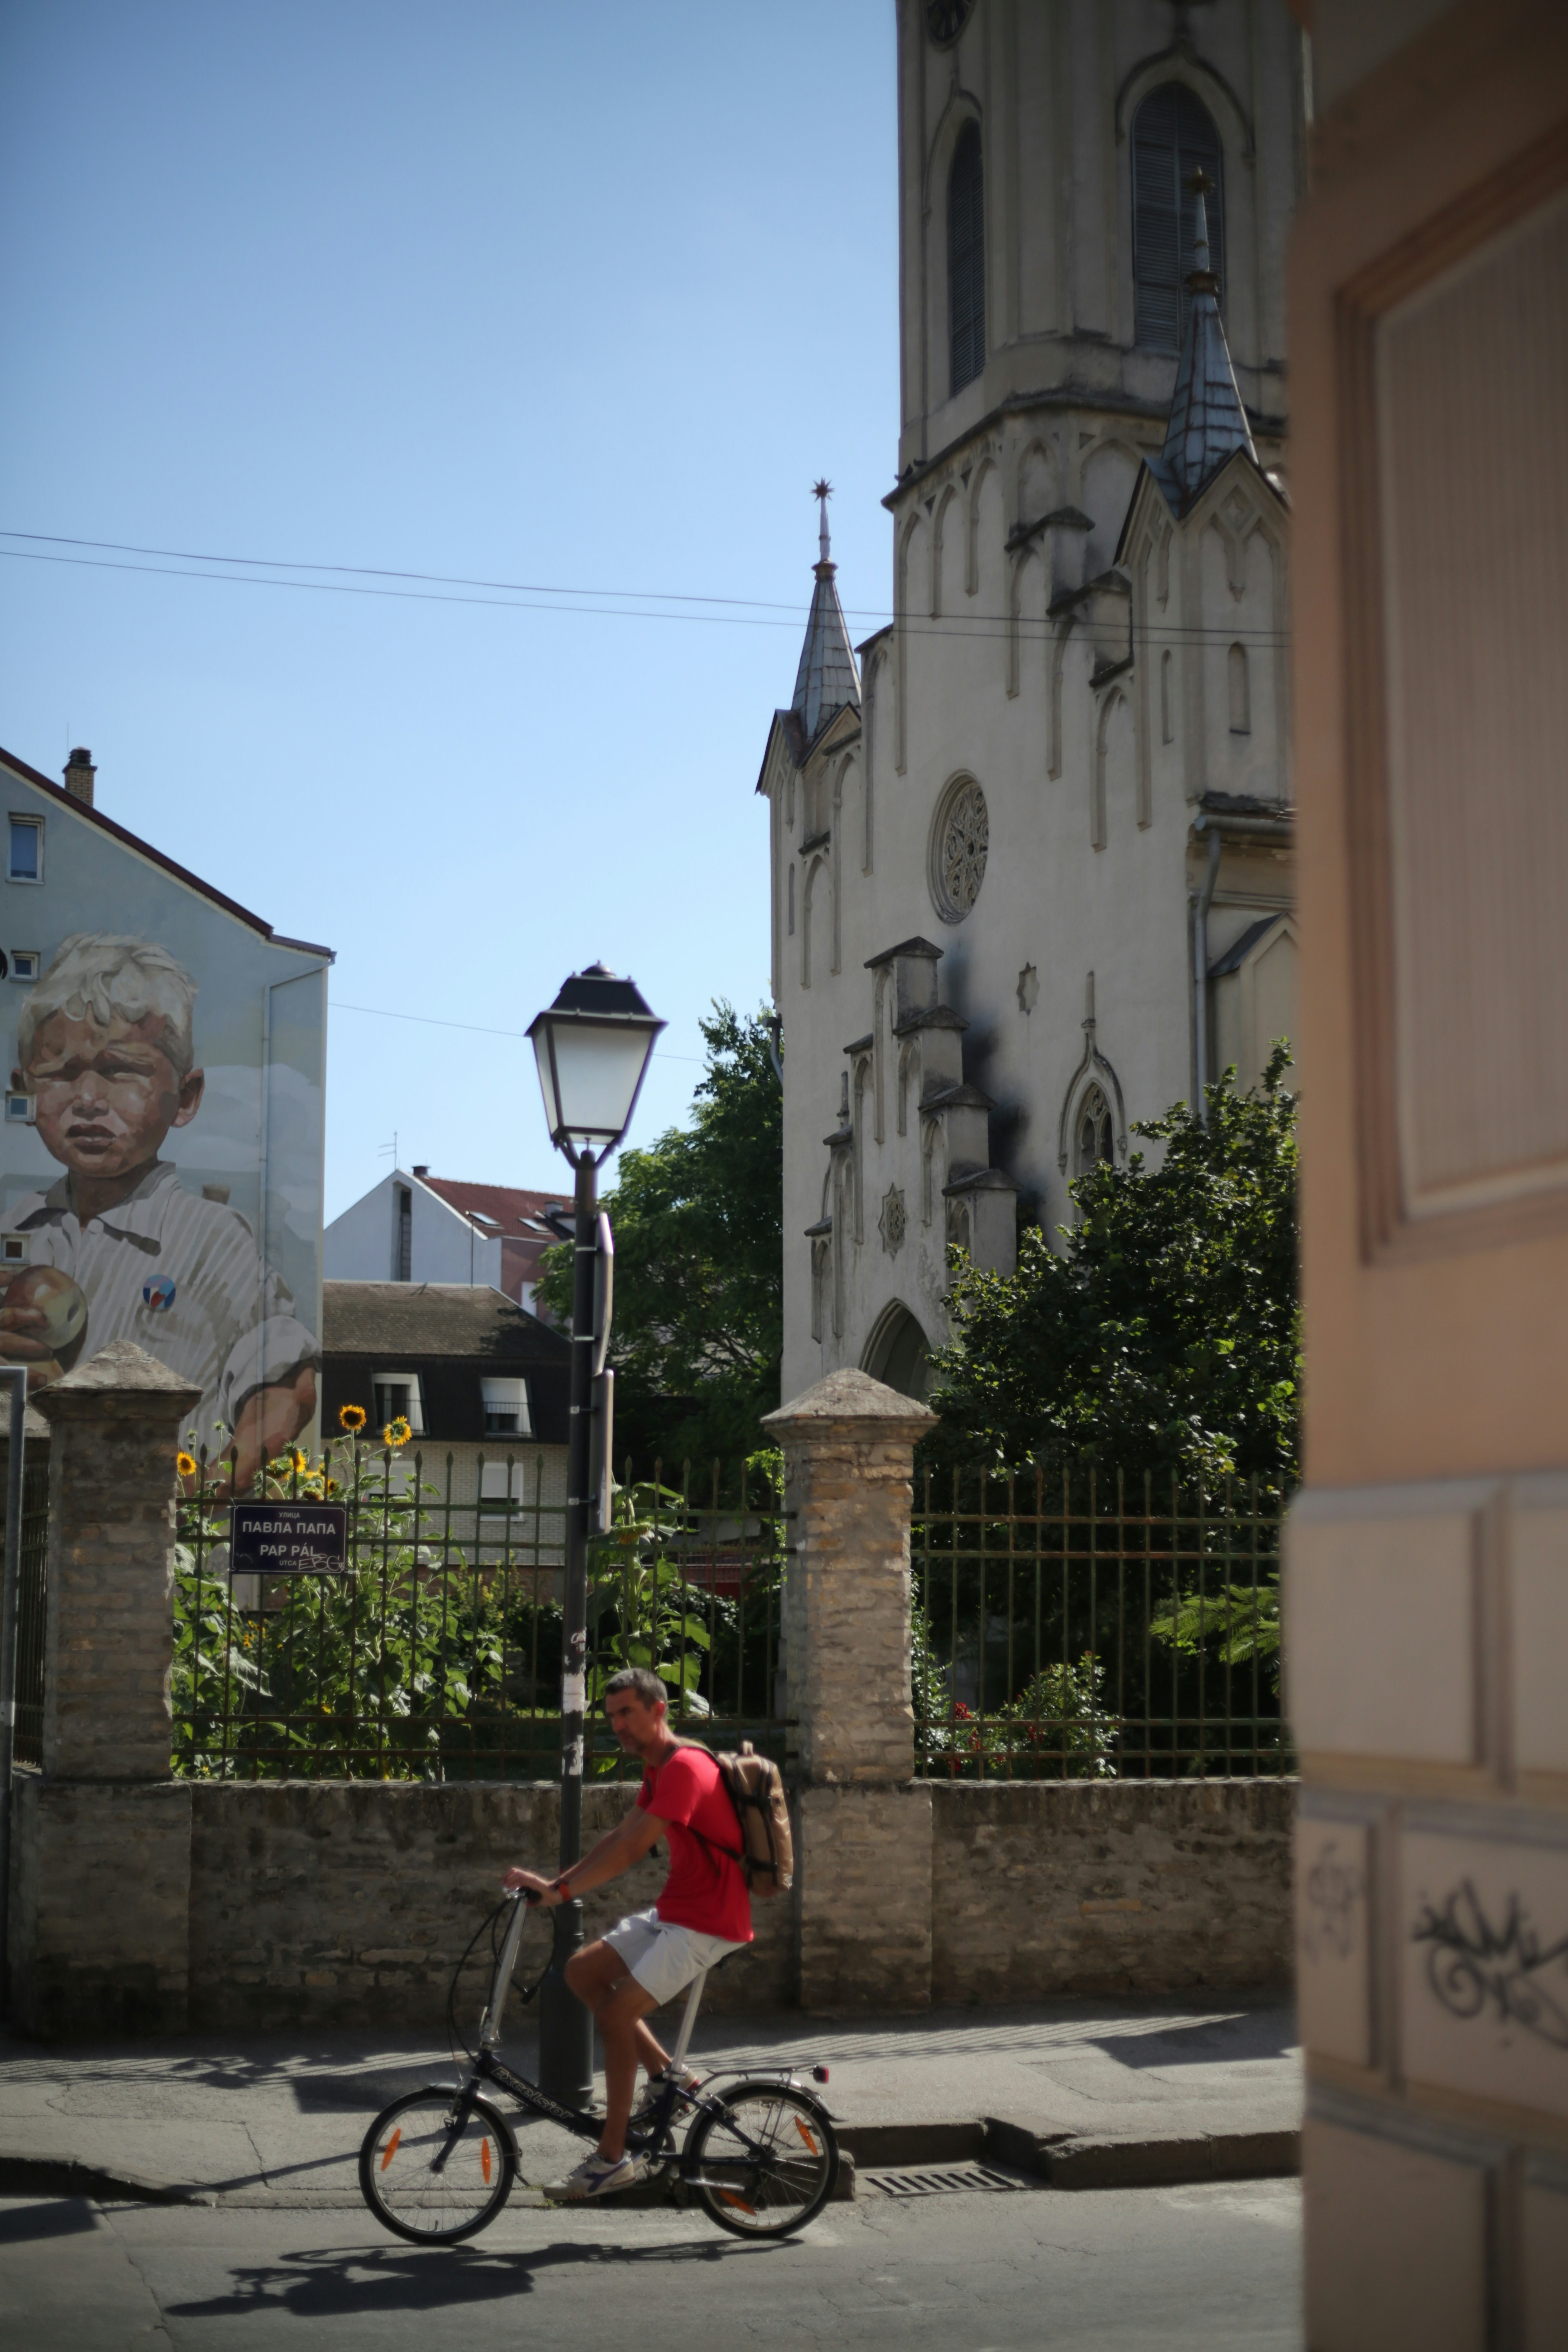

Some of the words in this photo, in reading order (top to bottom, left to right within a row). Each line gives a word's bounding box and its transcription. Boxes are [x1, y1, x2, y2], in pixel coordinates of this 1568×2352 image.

[243, 1521, 292, 1533] ПАВЛА
[296, 1522, 336, 1535] ПАПА
[260, 1545, 287, 1556] PAP
[291, 1542, 318, 1557] PÁL
[490, 2066, 575, 2119] Excelsior
